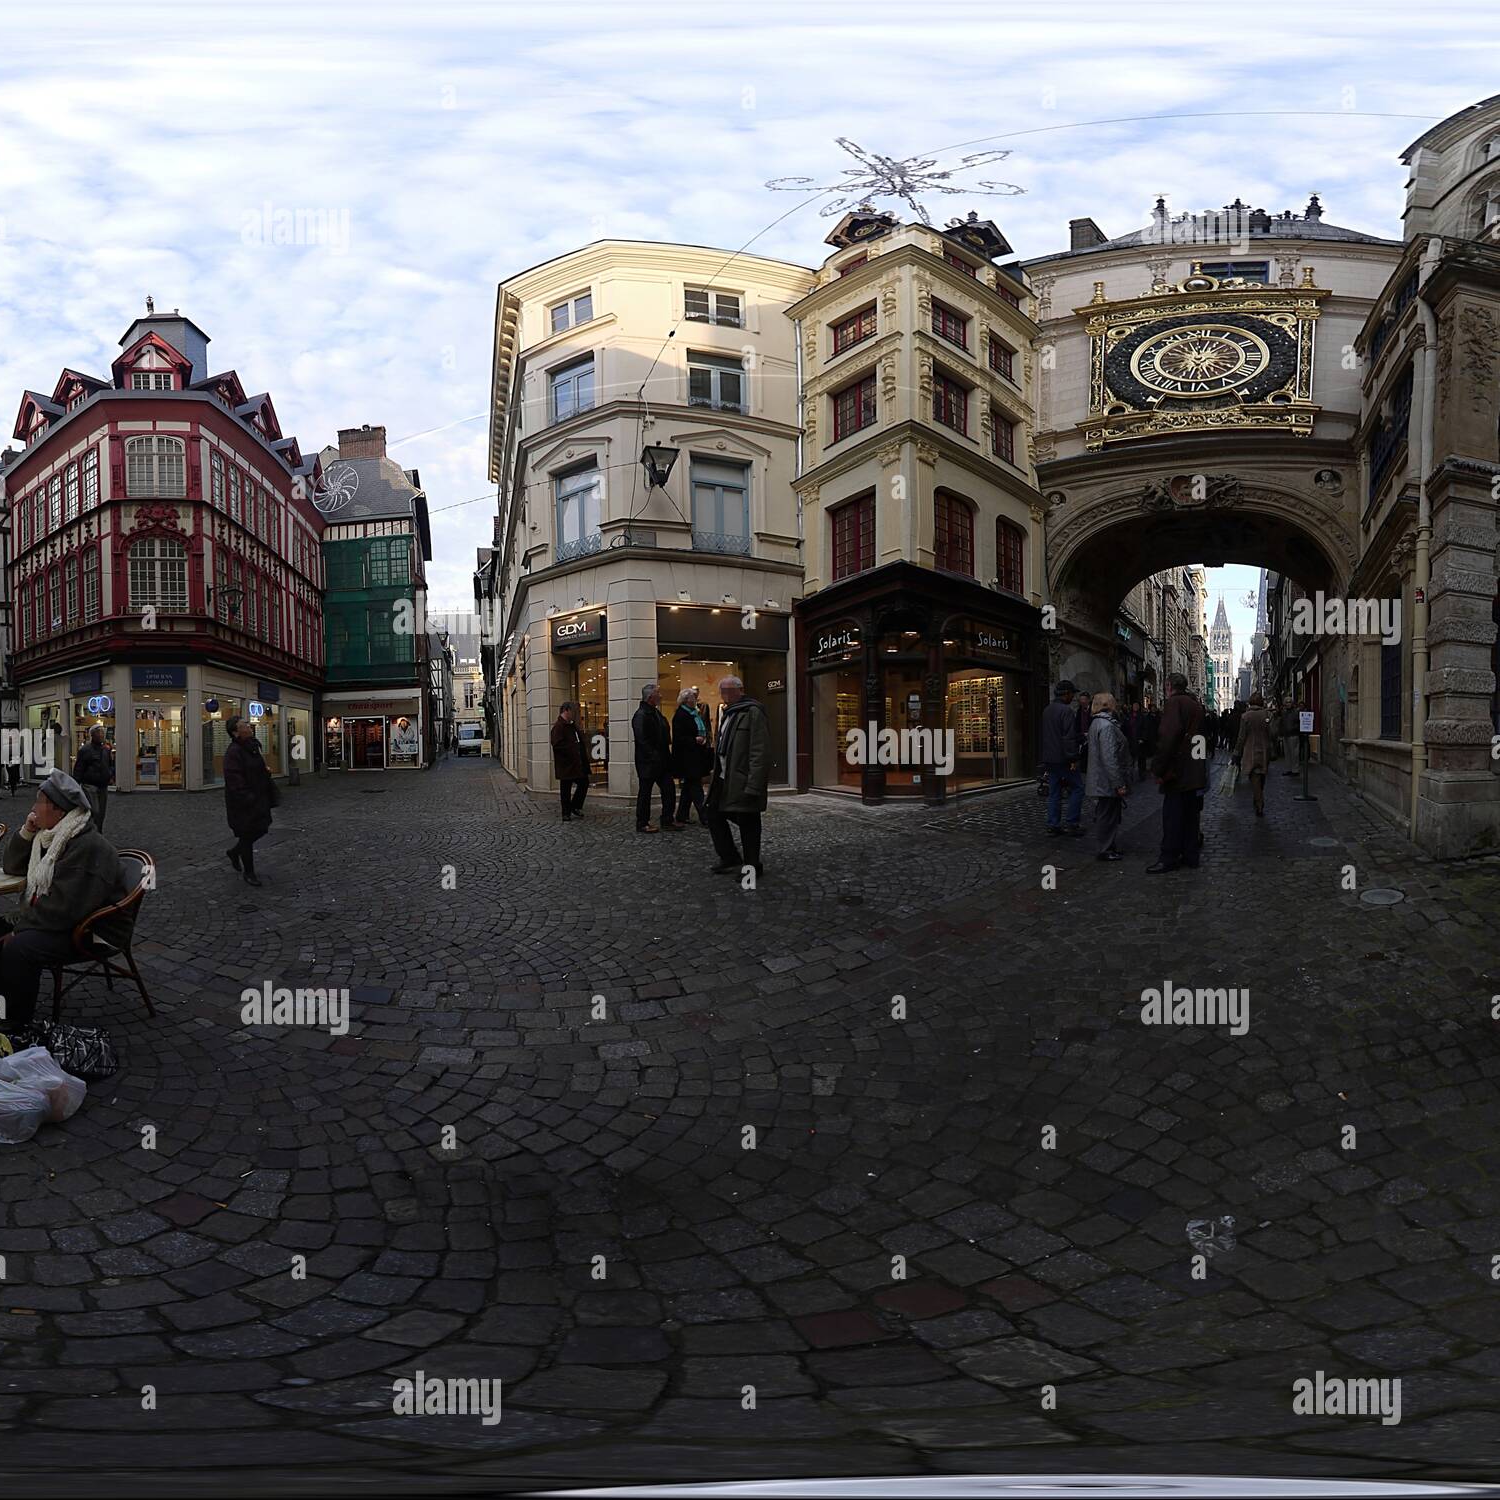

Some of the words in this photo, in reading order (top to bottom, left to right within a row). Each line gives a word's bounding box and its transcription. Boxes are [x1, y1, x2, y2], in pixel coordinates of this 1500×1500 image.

[557, 621, 587, 638] GDM
[817, 629, 852, 654] Solaris
[977, 631, 1010, 650] Solaris
